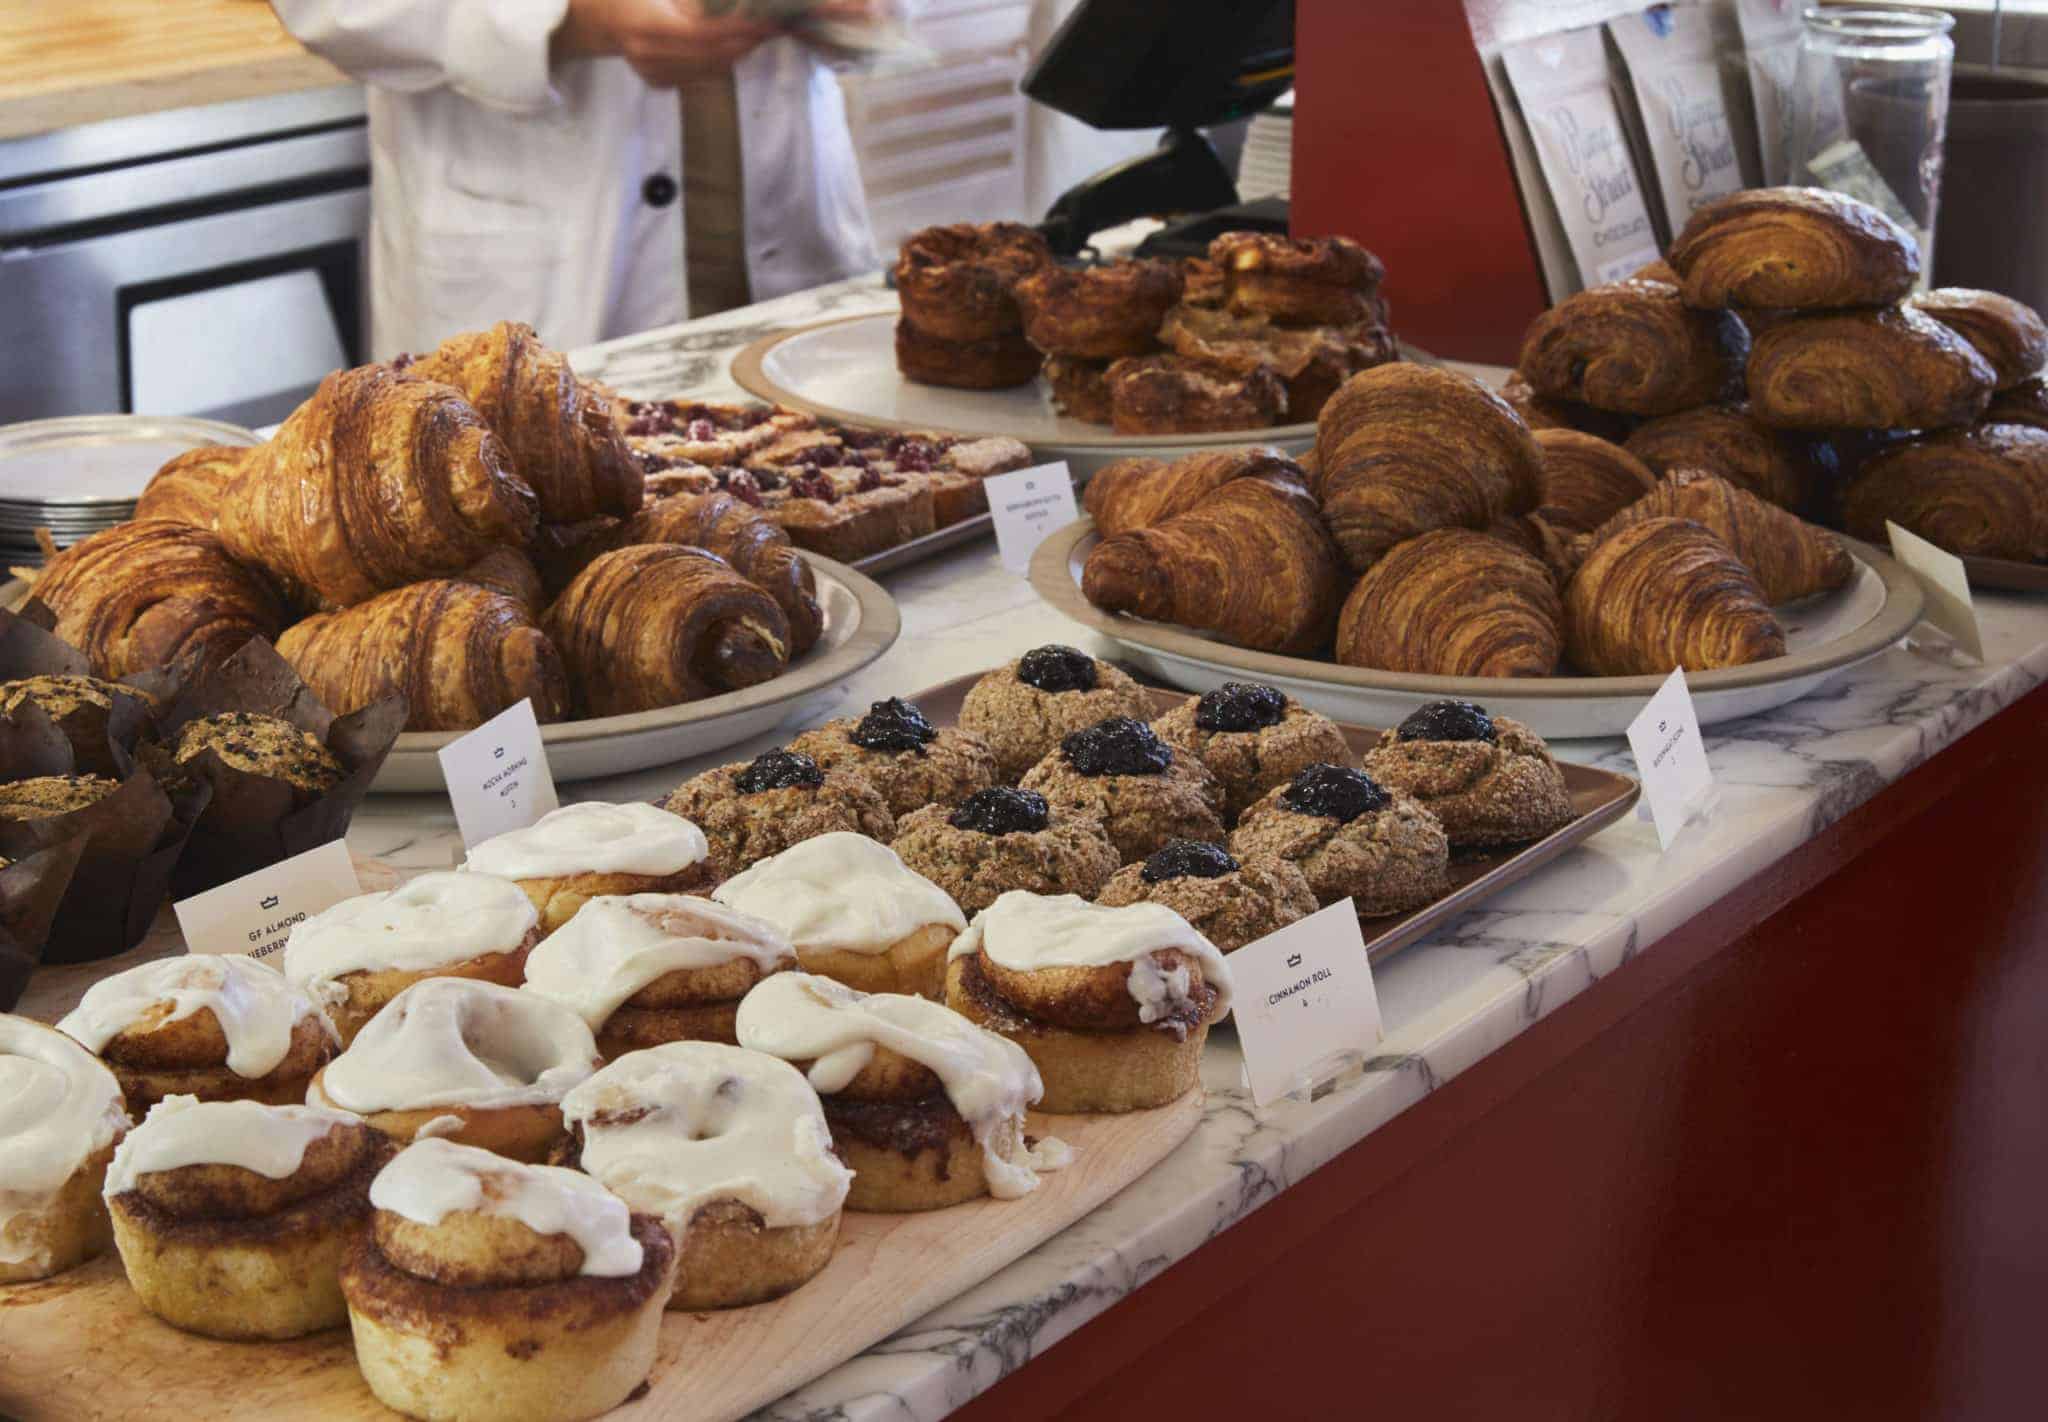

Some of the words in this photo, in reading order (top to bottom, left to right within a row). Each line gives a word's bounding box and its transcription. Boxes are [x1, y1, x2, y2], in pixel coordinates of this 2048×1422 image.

[248, 930, 262, 942] GF
[266, 911, 306, 935] ALMOND
[247, 935, 290, 959] UEBERRY
[1268, 976, 1311, 1005] CINNAMON
[1311, 967, 1332, 984] ROLL
